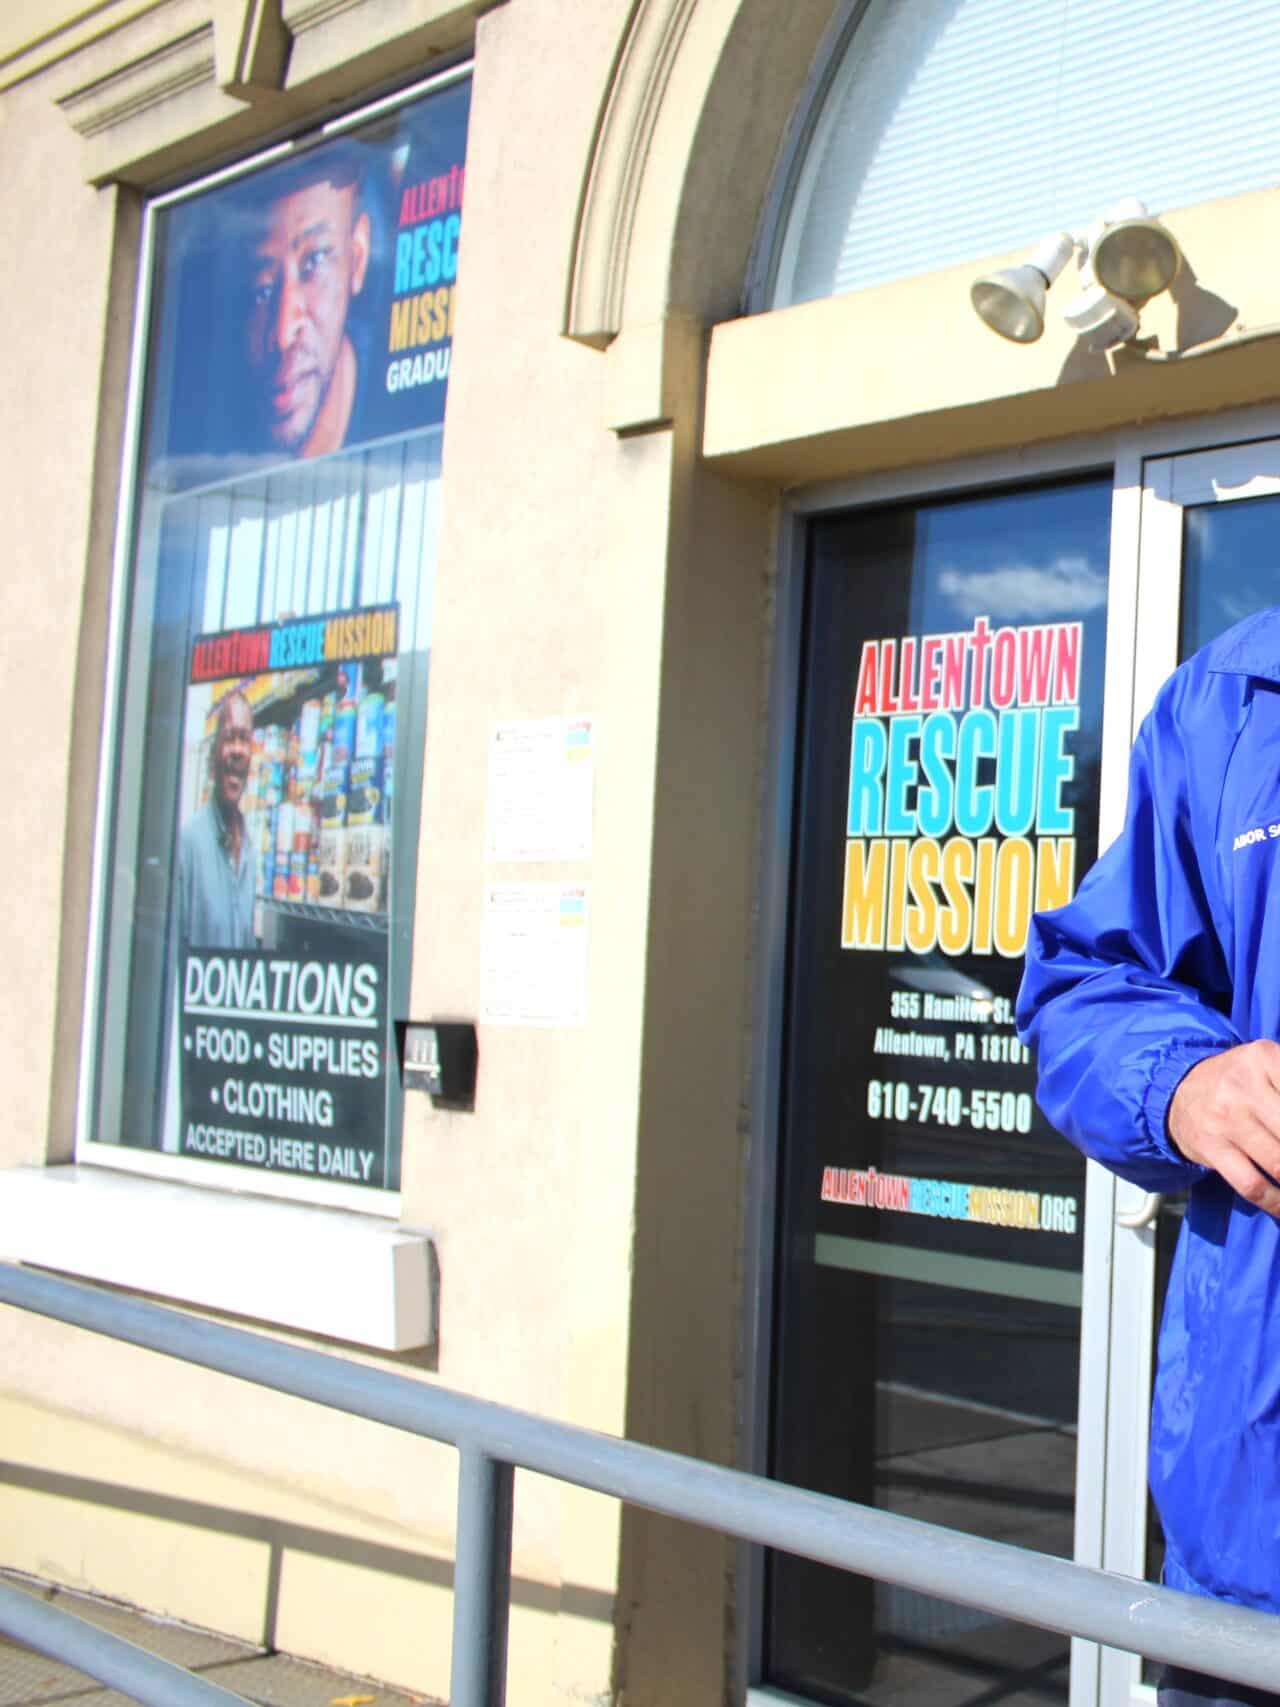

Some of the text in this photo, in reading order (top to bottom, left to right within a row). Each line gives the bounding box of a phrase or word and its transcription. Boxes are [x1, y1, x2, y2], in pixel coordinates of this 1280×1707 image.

[394, 214, 461, 293] RESC
[386, 348, 450, 392] GRADU
[854, 616, 1084, 717] ALLENTOWN
[847, 705, 1080, 837] RESCUE
[841, 836, 1076, 958] MISSION
[185, 957, 378, 1017] DONATIONS
[891, 991, 1014, 1024] 355 Hamilton St.
[196, 1026, 380, 1078] FOOD SUPPLIES
[873, 1027, 1029, 1064] Allentown, PA 18101
[223, 1078, 334, 1127] CLOTHING
[867, 1079, 1033, 1134] 610-740-5500
[186, 1123, 375, 1181] ACCEPTED HERE DAILY
